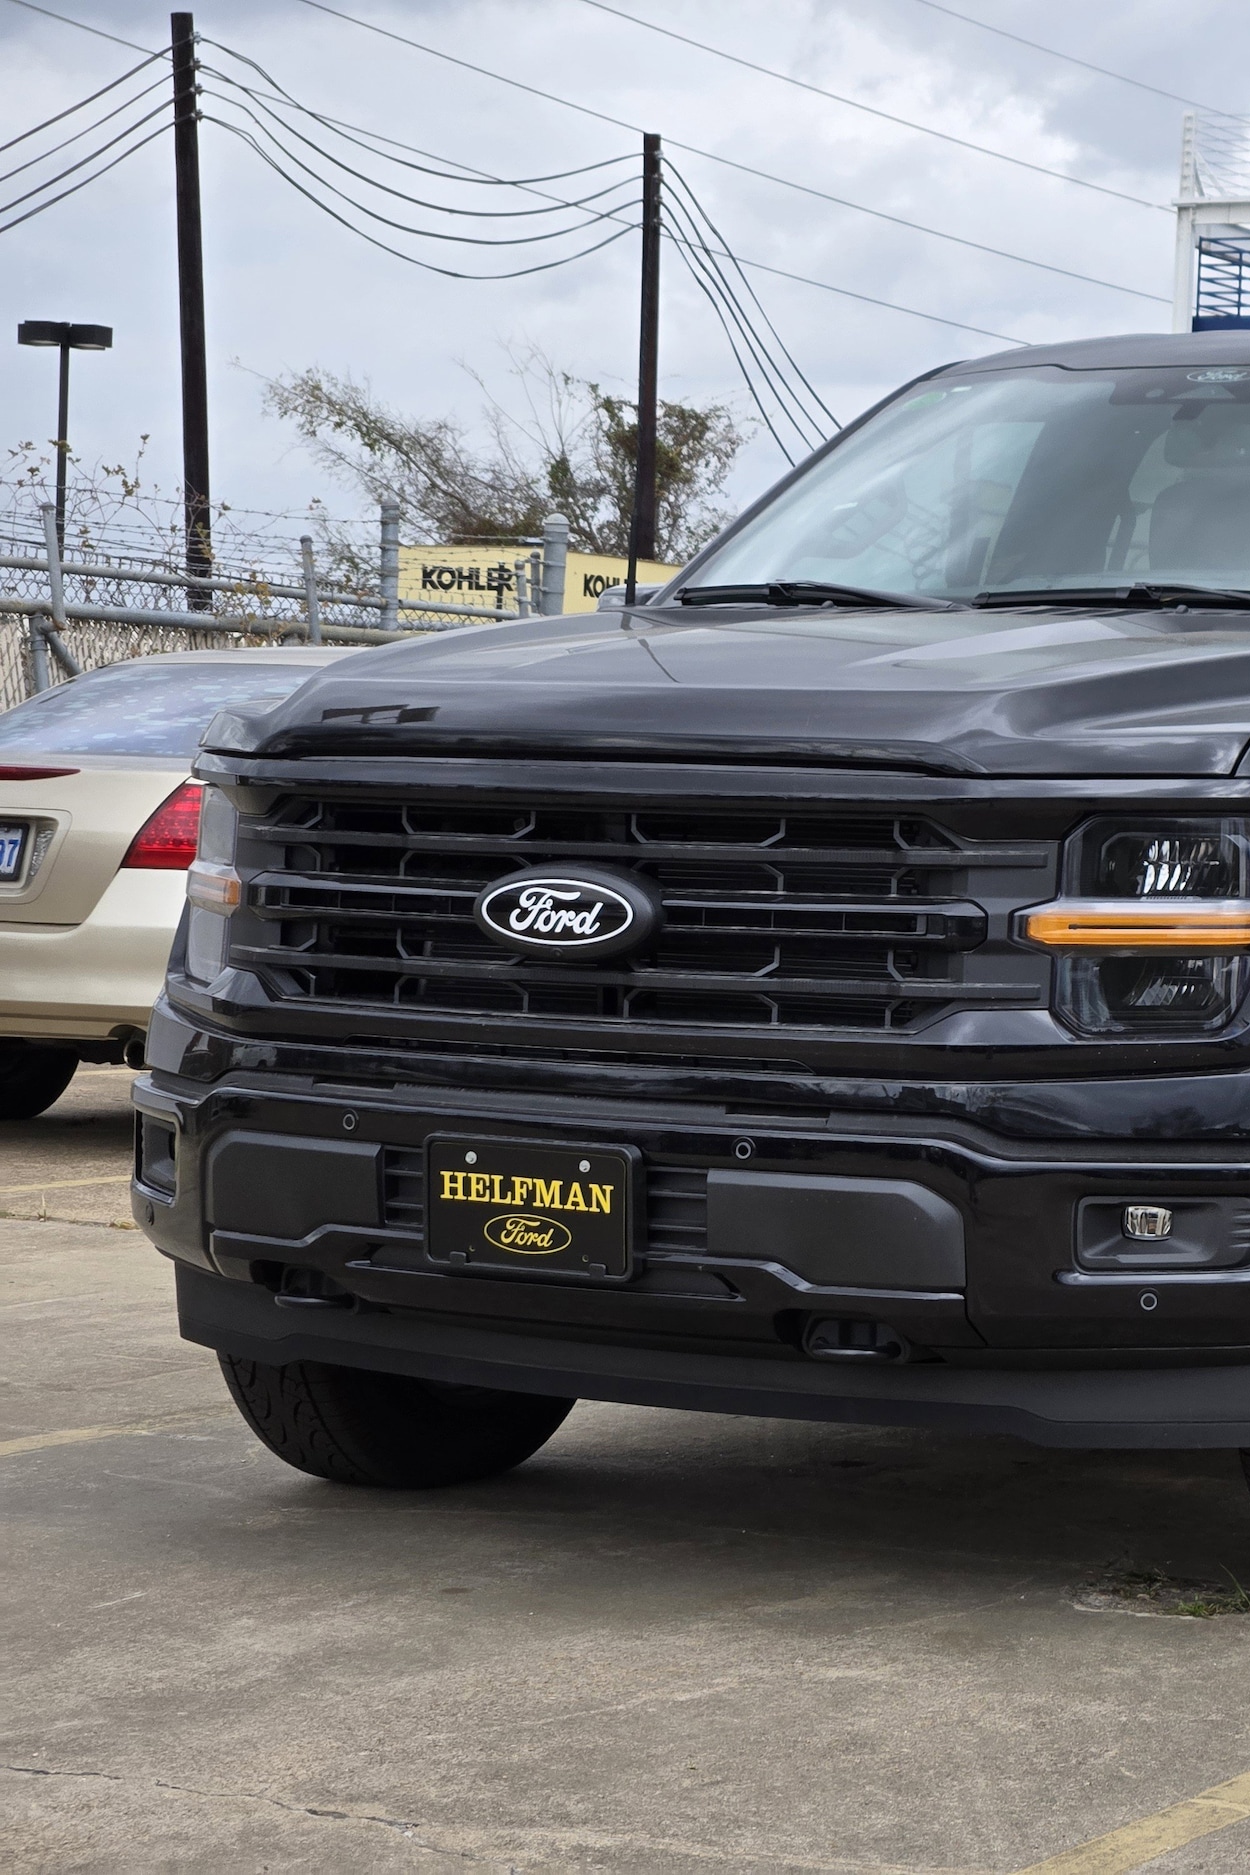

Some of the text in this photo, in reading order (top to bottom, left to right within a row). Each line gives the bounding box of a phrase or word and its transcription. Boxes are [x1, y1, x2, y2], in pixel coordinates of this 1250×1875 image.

[422, 566, 514, 592] KOHLER
[509, 887, 604, 935] Ford
[440, 1170, 615, 1214] HELFMAN
[500, 1217, 555, 1248] Ford
